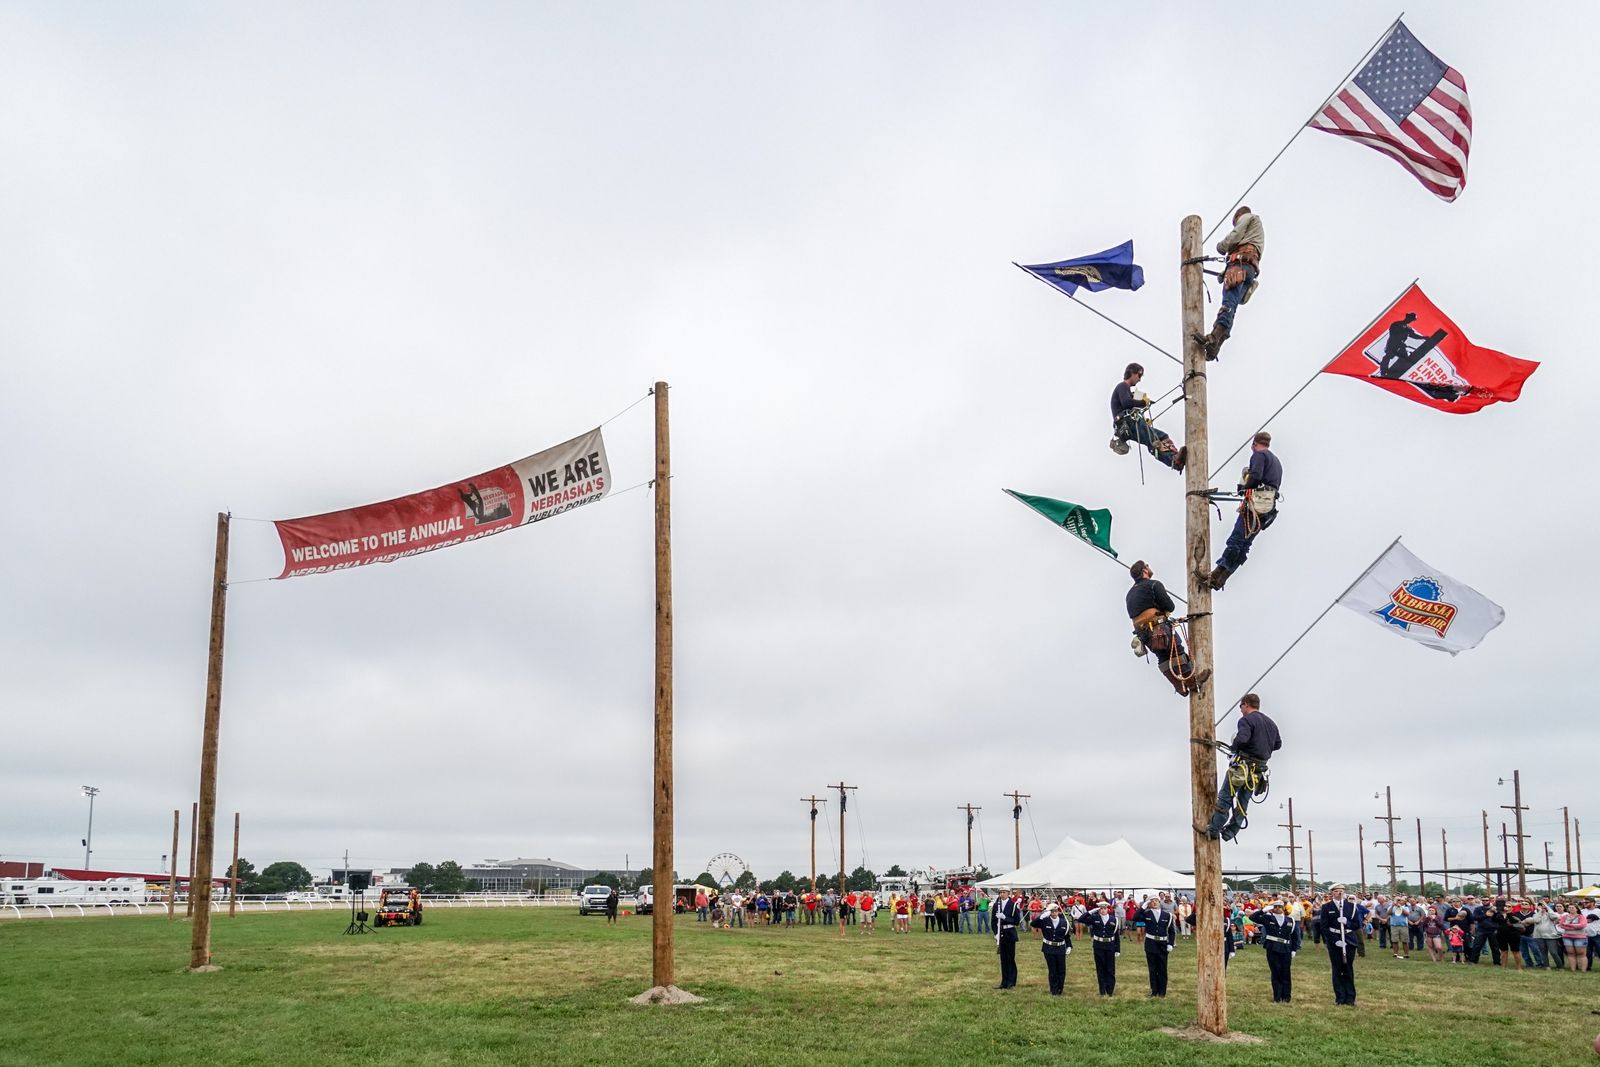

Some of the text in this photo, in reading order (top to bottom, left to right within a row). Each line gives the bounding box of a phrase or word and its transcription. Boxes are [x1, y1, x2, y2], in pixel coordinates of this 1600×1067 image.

[528, 451, 602, 497] WE ARE
[528, 492, 603, 523] PUBLIC POWER
[531, 476, 604, 513] NEBRASKA'S
[292, 516, 463, 562] WELCOME TO THE ANNUAL
[1394, 590, 1453, 618] NEBRASKA
[1395, 607, 1448, 630] STATE FAIR
